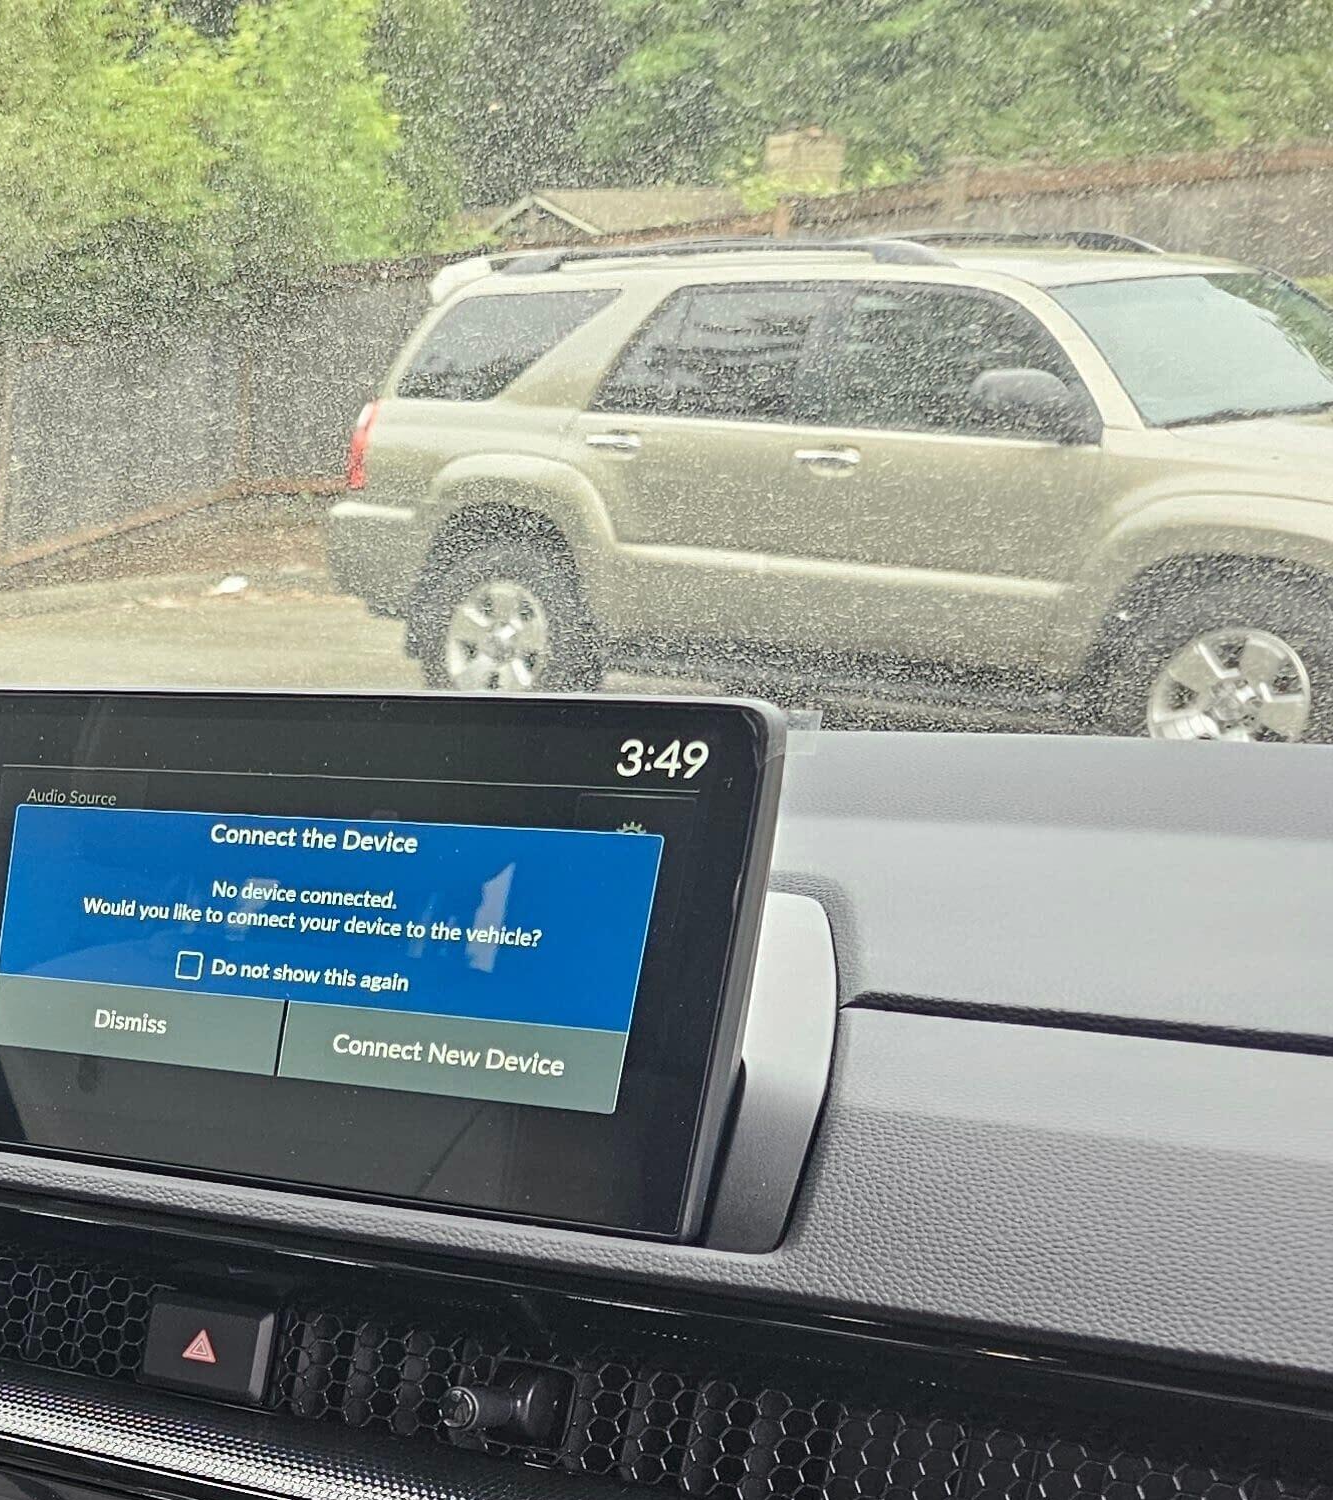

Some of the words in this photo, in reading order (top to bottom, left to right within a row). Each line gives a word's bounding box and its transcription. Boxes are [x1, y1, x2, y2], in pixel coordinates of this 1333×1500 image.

[615, 738, 709, 780] 3:49
[26, 788, 67, 805] Audio
[69, 789, 117, 806] Source
[210, 823, 296, 848] Connect
[302, 826, 336, 850] the
[342, 830, 419, 854] Device
[212, 880, 238, 900] No
[241, 882, 297, 904] device
[300, 886, 397, 910] connected.
[83, 897, 135, 918] Would
[139, 903, 170, 921] you
[173, 903, 202, 923] like
[205, 907, 224, 924] to
[227, 911, 296, 930] connect
[299, 915, 341, 933] your
[343, 914, 402, 938] device
[406, 921, 426, 938] to
[430, 921, 462, 941] the
[466, 925, 543, 948] vehicle?
[211, 958, 237, 977] Do
[240, 961, 271, 980] not
[273, 962, 320, 984] show
[324, 966, 356, 987] this
[359, 971, 410, 993] again
[93, 1008, 168, 1037] Dismiss
[332, 1033, 423, 1063] Connect
[427, 1041, 481, 1068] New
[485, 1046, 565, 1077] Device
